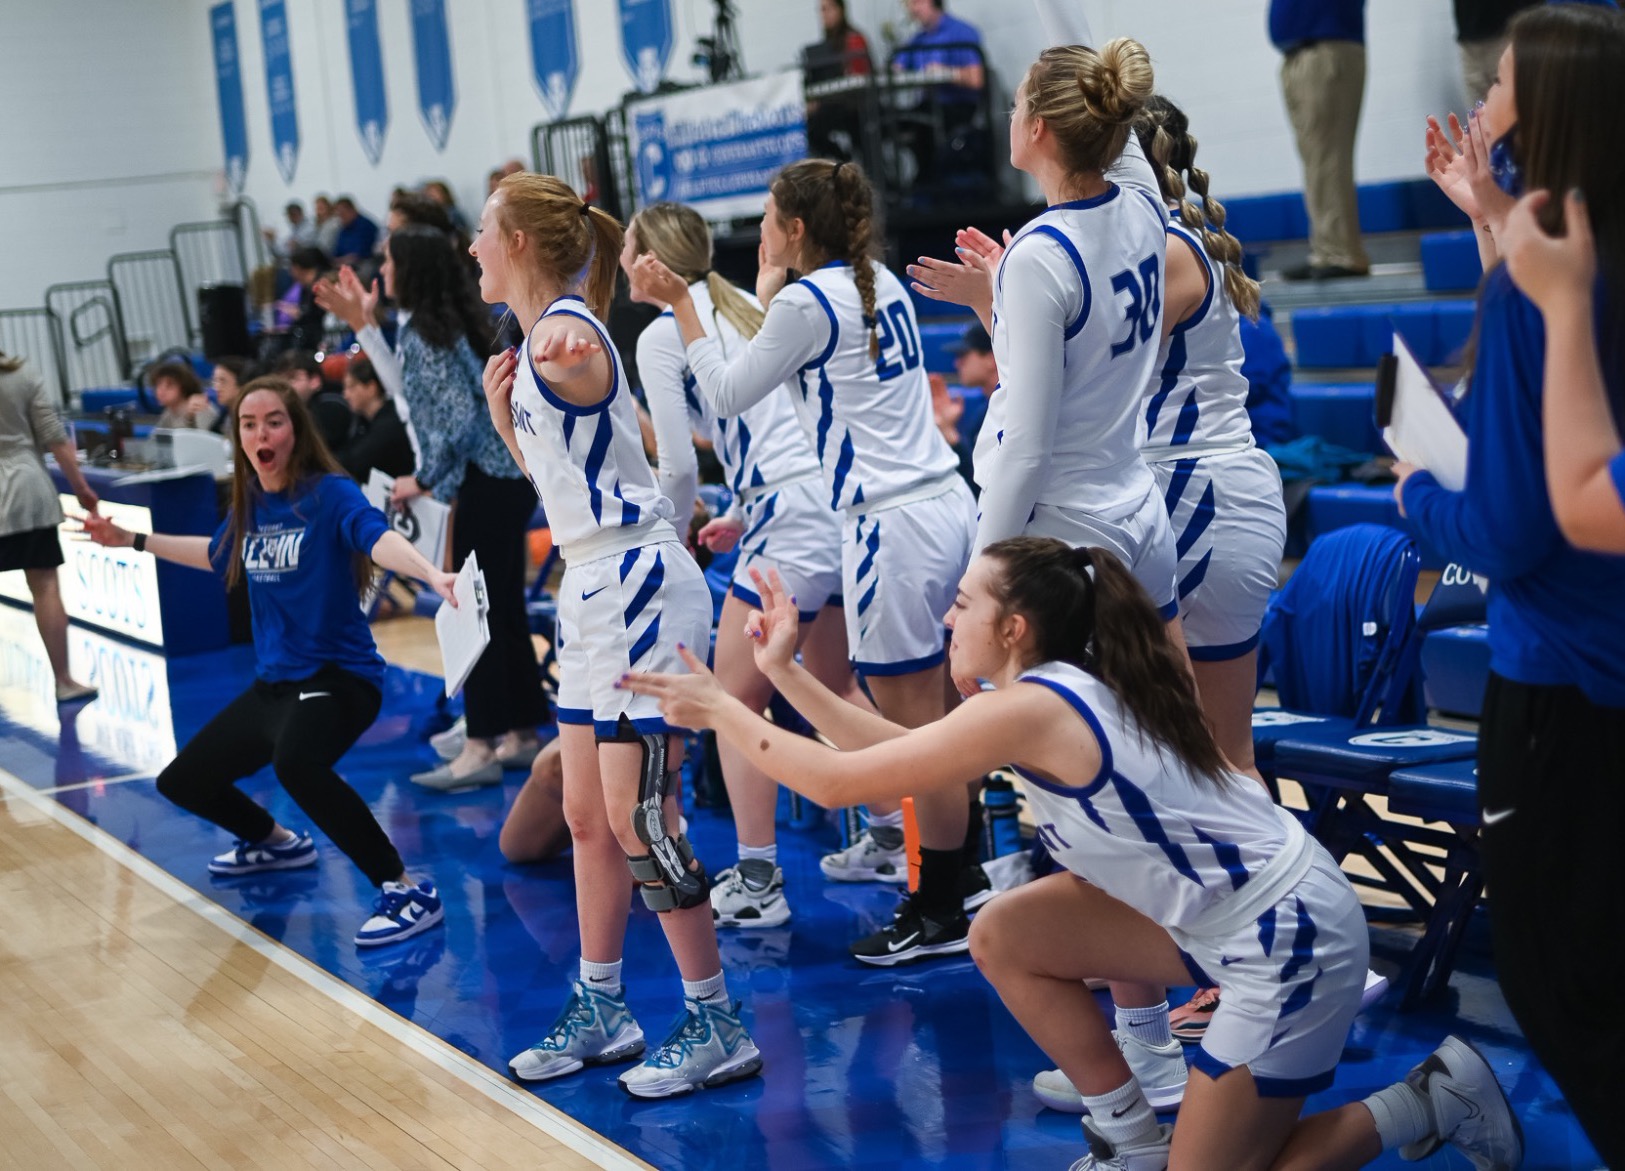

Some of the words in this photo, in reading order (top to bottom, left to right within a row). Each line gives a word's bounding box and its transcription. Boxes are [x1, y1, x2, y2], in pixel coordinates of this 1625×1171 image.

[863, 300, 919, 382] 20
[1110, 252, 1160, 360] 30
[77, 550, 146, 628] SCOTS
